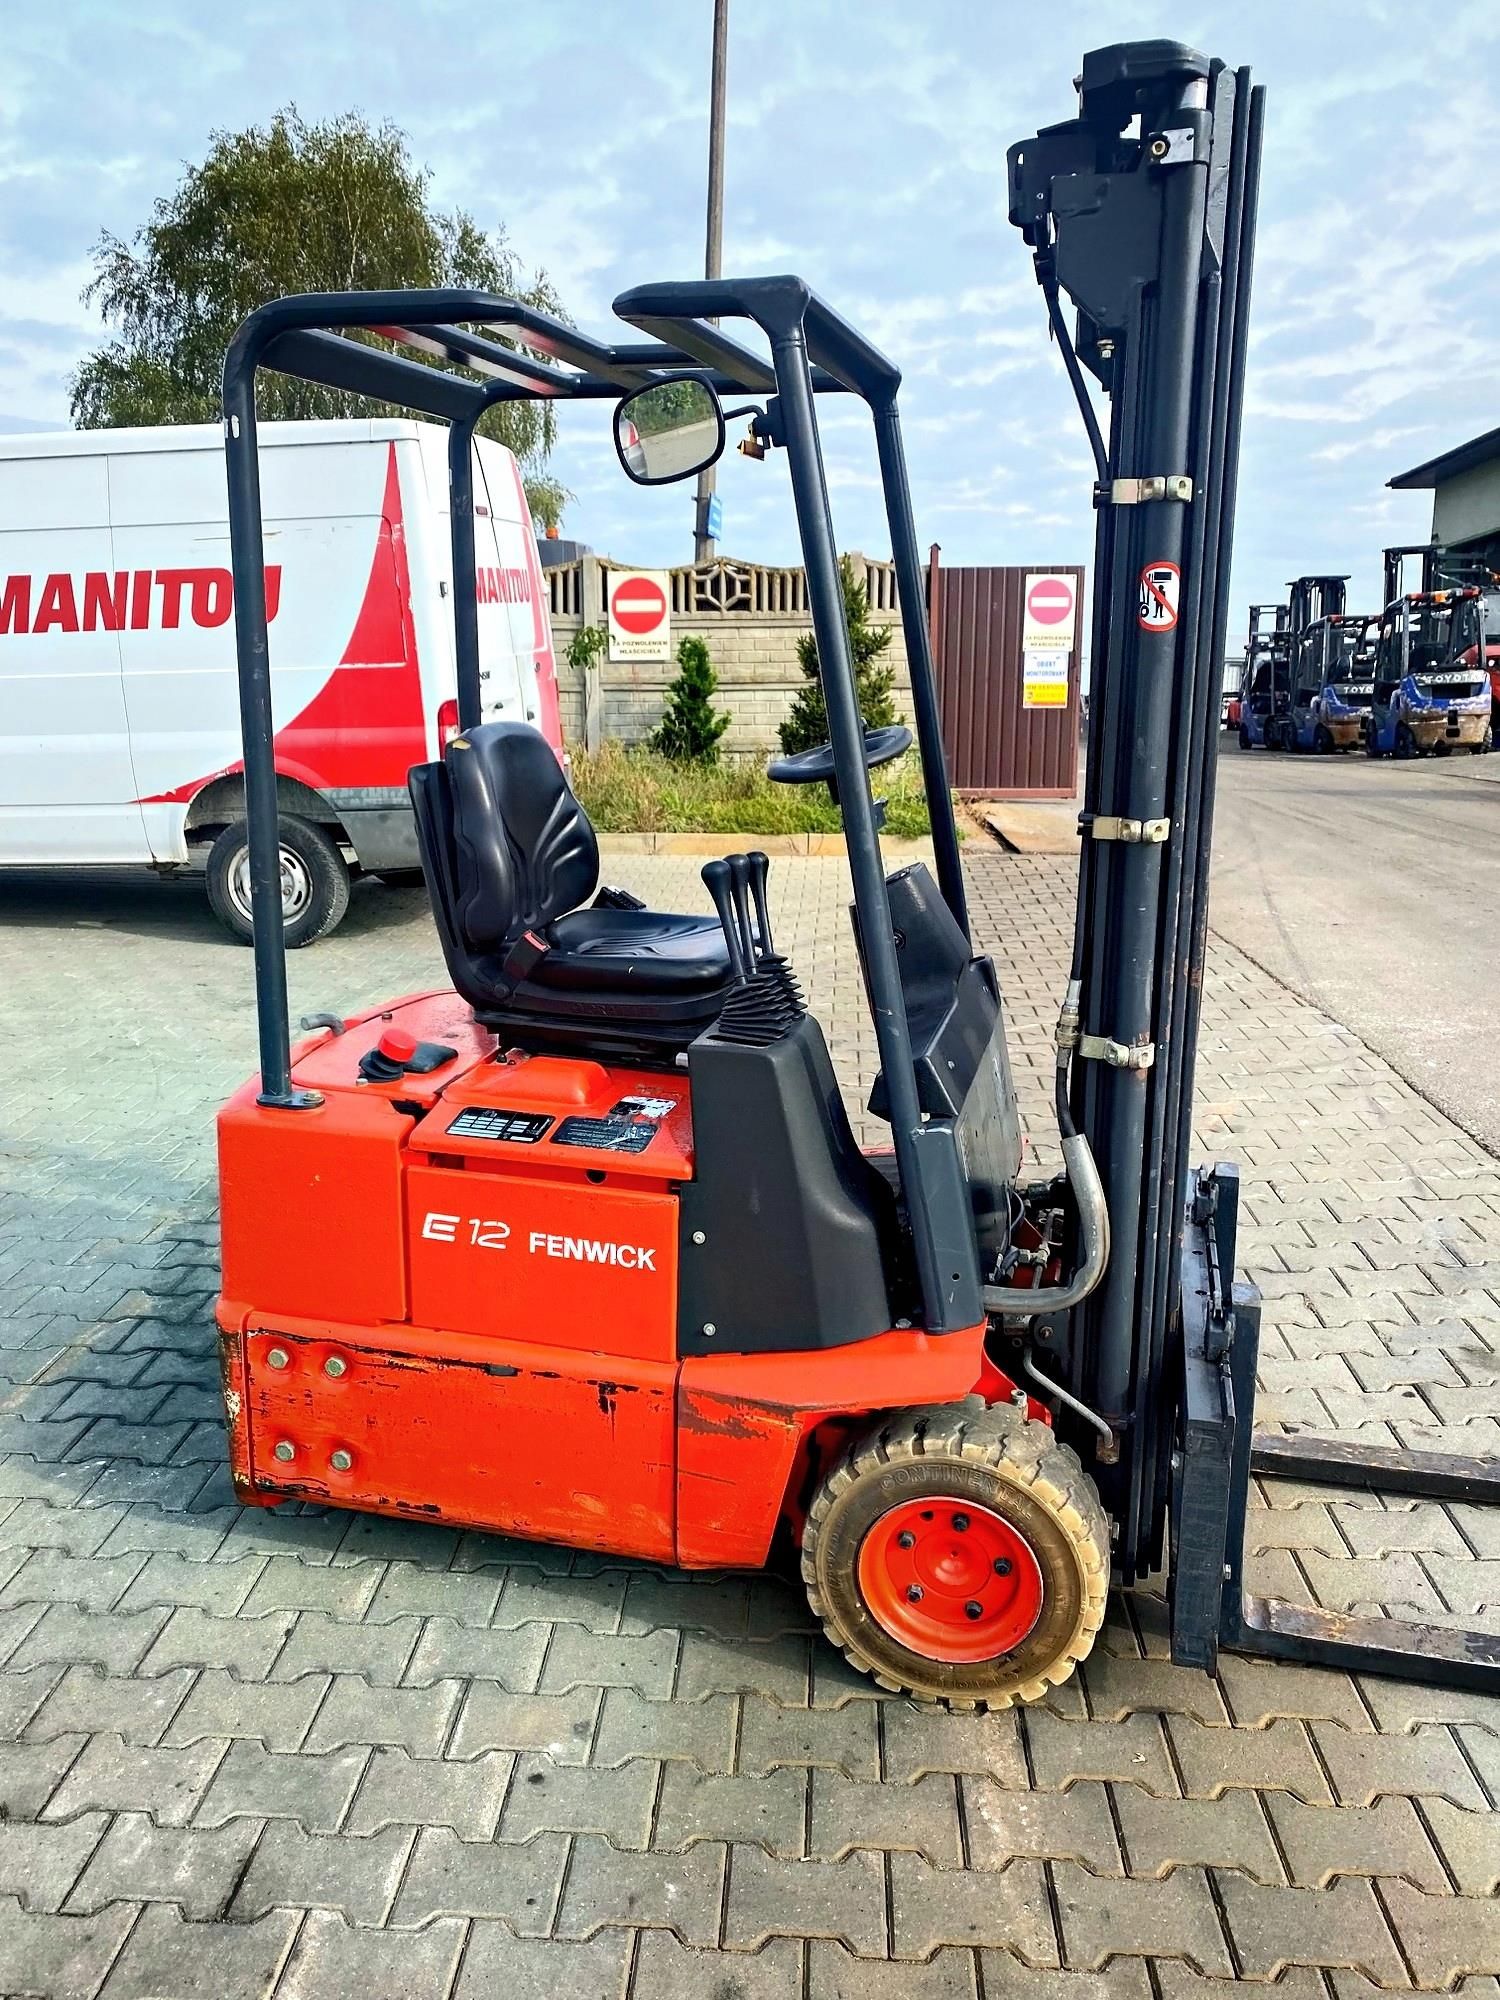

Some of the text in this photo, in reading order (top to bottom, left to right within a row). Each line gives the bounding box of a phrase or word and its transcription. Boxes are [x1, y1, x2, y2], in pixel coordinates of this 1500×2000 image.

[476, 567, 531, 604] MANITOU
[1343, 686, 1373, 695] TOYO
[1426, 672, 1480, 684] TOYOTA
[422, 1212, 511, 1250] E 12
[529, 1231, 657, 1272] FENWICK
[881, 1463, 1032, 1521] CONTINENTAL
